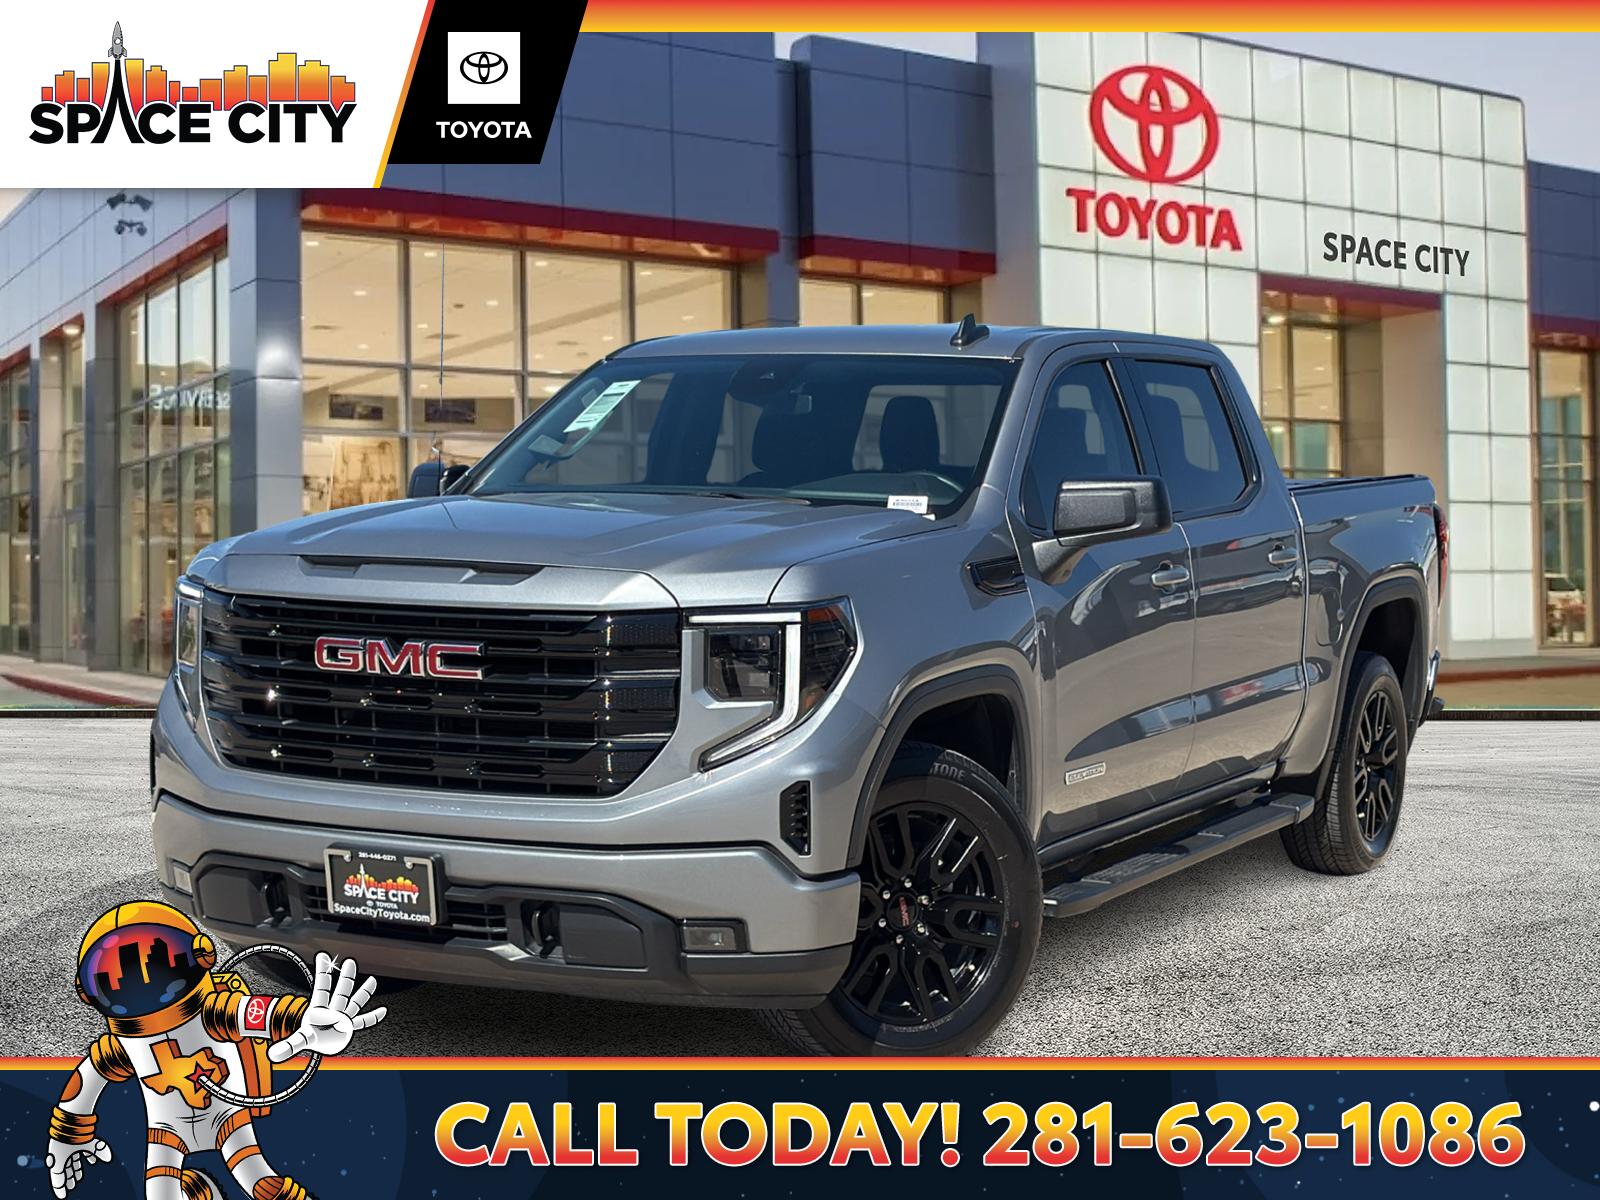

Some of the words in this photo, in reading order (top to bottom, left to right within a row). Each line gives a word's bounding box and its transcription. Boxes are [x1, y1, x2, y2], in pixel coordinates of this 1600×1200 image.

[1065, 187, 1243, 252] TOYOTA
[1322, 231, 1408, 270] SPACE
[1414, 243, 1471, 278] CITY
[314, 635, 484, 681] GMC
[344, 883, 386, 900] SPACE
[388, 889, 419, 904] CITY
[376, 901, 398, 909] TOYOTA
[333, 903, 430, 923] SpaceCityToyota.com
